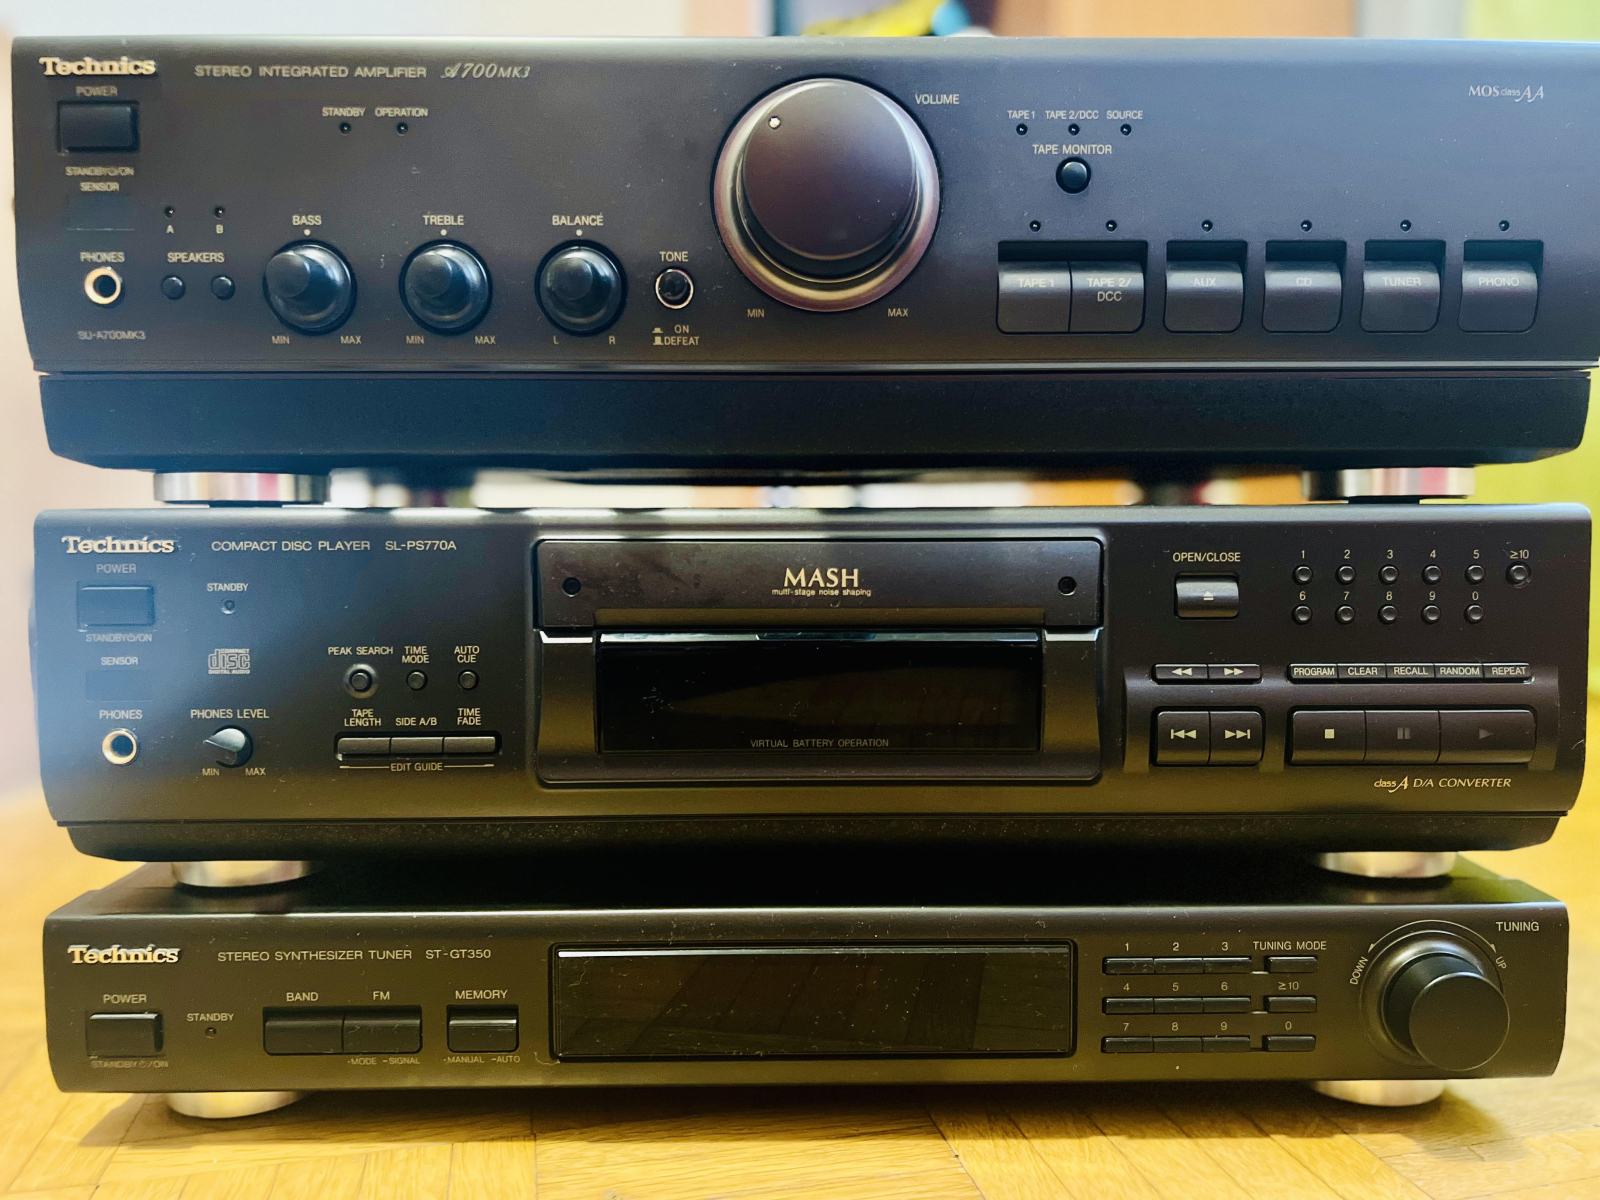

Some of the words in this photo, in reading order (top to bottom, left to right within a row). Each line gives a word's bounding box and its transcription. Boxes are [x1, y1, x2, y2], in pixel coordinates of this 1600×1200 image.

[38, 55, 157, 77] Technics
[194, 64, 252, 78] STEREO
[258, 65, 349, 78] INTEGRATED
[353, 66, 428, 79] AMPLIFIER
[75, 85, 118, 98] POWER
[1468, 84, 1500, 97] MOS
[914, 93, 960, 105] VOLUME
[321, 106, 367, 118] STANDBY
[374, 107, 429, 118] OPERATION
[1007, 109, 1030, 120] TAPE
[1044, 109, 1068, 120] TAPE
[1068, 109, 1100, 120] 2/DCC
[1105, 110, 1144, 120] SOURCE
[1031, 144, 1059, 155] TAPE
[1062, 144, 1113, 155] MONITOR
[79, 181, 120, 193] SENSOR
[291, 214, 322, 226] BASS
[422, 215, 465, 226] TREBLE
[552, 215, 604, 226] BALANCE
[165, 224, 175, 235] A
[215, 224, 224, 235] B
[79, 251, 126, 264] PHONES
[166, 251, 225, 264] SPEAKERS
[659, 251, 689, 263] TONE
[1017, 277, 1047, 289] TAPE
[1086, 277, 1117, 288] TAPE
[1191, 277, 1217, 288] AUX
[1295, 276, 1313, 287] CD
[1381, 276, 1423, 287] TUNER
[1478, 276, 1520, 287] PHONO
[1096, 291, 1123, 302] DCC
[747, 308, 765, 319] MIN
[887, 307, 909, 318] MAX
[673, 323, 690, 334] ON
[271, 335, 290, 345] MIN
[340, 335, 362, 345] MAX
[405, 335, 425, 345] MIN
[474, 335, 497, 345] MAX
[553, 335, 559, 345] L
[608, 335, 616, 345] R
[663, 335, 700, 346] DEFEAT
[61, 535, 176, 554] Technics
[211, 540, 278, 551] COMPACT
[281, 540, 312, 551] DISC
[318, 540, 371, 551] PLAYER
[384, 540, 457, 551] SL-PS770A
[1172, 552, 1241, 562] OPEN/CLOSE
[1343, 550, 1351, 559] 2
[1386, 550, 1394, 559] 3
[1429, 550, 1437, 559] 4
[1473, 550, 1480, 559] 5
[96, 563, 137, 574] POWER
[783, 567, 859, 588] MASH
[206, 582, 249, 592] STANDBY
[771, 588, 816, 598] multi-stage
[818, 588, 840, 596] noise
[842, 588, 872, 598] shaping
[1299, 591, 1306, 601] 6
[1343, 591, 1350, 601] 7
[1386, 591, 1393, 601] 8
[1429, 591, 1436, 601] 9
[1471, 591, 1479, 601] 0
[327, 646, 353, 656] PEAK
[355, 646, 394, 655] SEARCH
[404, 645, 428, 655] TIME
[453, 645, 480, 655] AUTO
[100, 656, 139, 666] SENSOR
[401, 655, 430, 664] MODE
[456, 654, 477, 663] CUE
[1293, 667, 1335, 676] PROGRAM
[1347, 666, 1378, 676] CLEAR
[1393, 666, 1429, 675] RECALL
[1439, 666, 1480, 676] RANDOM
[1491, 666, 1527, 676] REPEAT
[99, 709, 143, 720] PHONES
[190, 708, 233, 719] PHONES
[236, 708, 270, 719] LEVEL
[351, 708, 374, 718] TAPE
[457, 707, 481, 717] TIME
[344, 717, 382, 727] LENGTH
[395, 717, 417, 726] SIDE
[419, 717, 438, 726] A/B
[456, 716, 482, 726] FADE
[750, 739, 789, 748] VIRTUAL
[792, 739, 834, 748] BATTERY
[837, 738, 889, 748] OPERATION
[202, 767, 220, 776] MIN
[245, 767, 267, 776] MAX
[390, 762, 411, 772] EDIT
[414, 762, 444, 772] GUIDE
[1373, 778, 1397, 789] class
[1413, 778, 1435, 789] D/A
[1438, 777, 1512, 788] CONVERTER
[1495, 921, 1540, 932] TUNING
[1172, 942, 1180, 952] 2
[1221, 941, 1229, 952] 3
[1252, 940, 1292, 951] TUNING
[1296, 940, 1328, 951] MODE
[66, 943, 181, 965] Technics
[217, 951, 270, 962] STEREO
[274, 950, 363, 961] SYNTHESIZER
[367, 950, 413, 960] TUNER
[425, 948, 492, 960] ST-GT350
[1495, 956, 1508, 970] UP
[1349, 956, 1370, 986] DOWN
[1122, 982, 1130, 992] 4
[1172, 982, 1180, 992] 5
[1220, 981, 1229, 991] 6
[103, 994, 148, 1004] POWER
[286, 992, 319, 1002] BAND
[372, 991, 391, 1001] FM
[454, 989, 508, 1000] MEMORY
[186, 1013, 235, 1022] STANDBY
[1122, 1022, 1130, 1032] 7
[1171, 1021, 1179, 1032] 8
[1220, 1021, 1228, 1031] 9
[1284, 1021, 1292, 1031] 0
